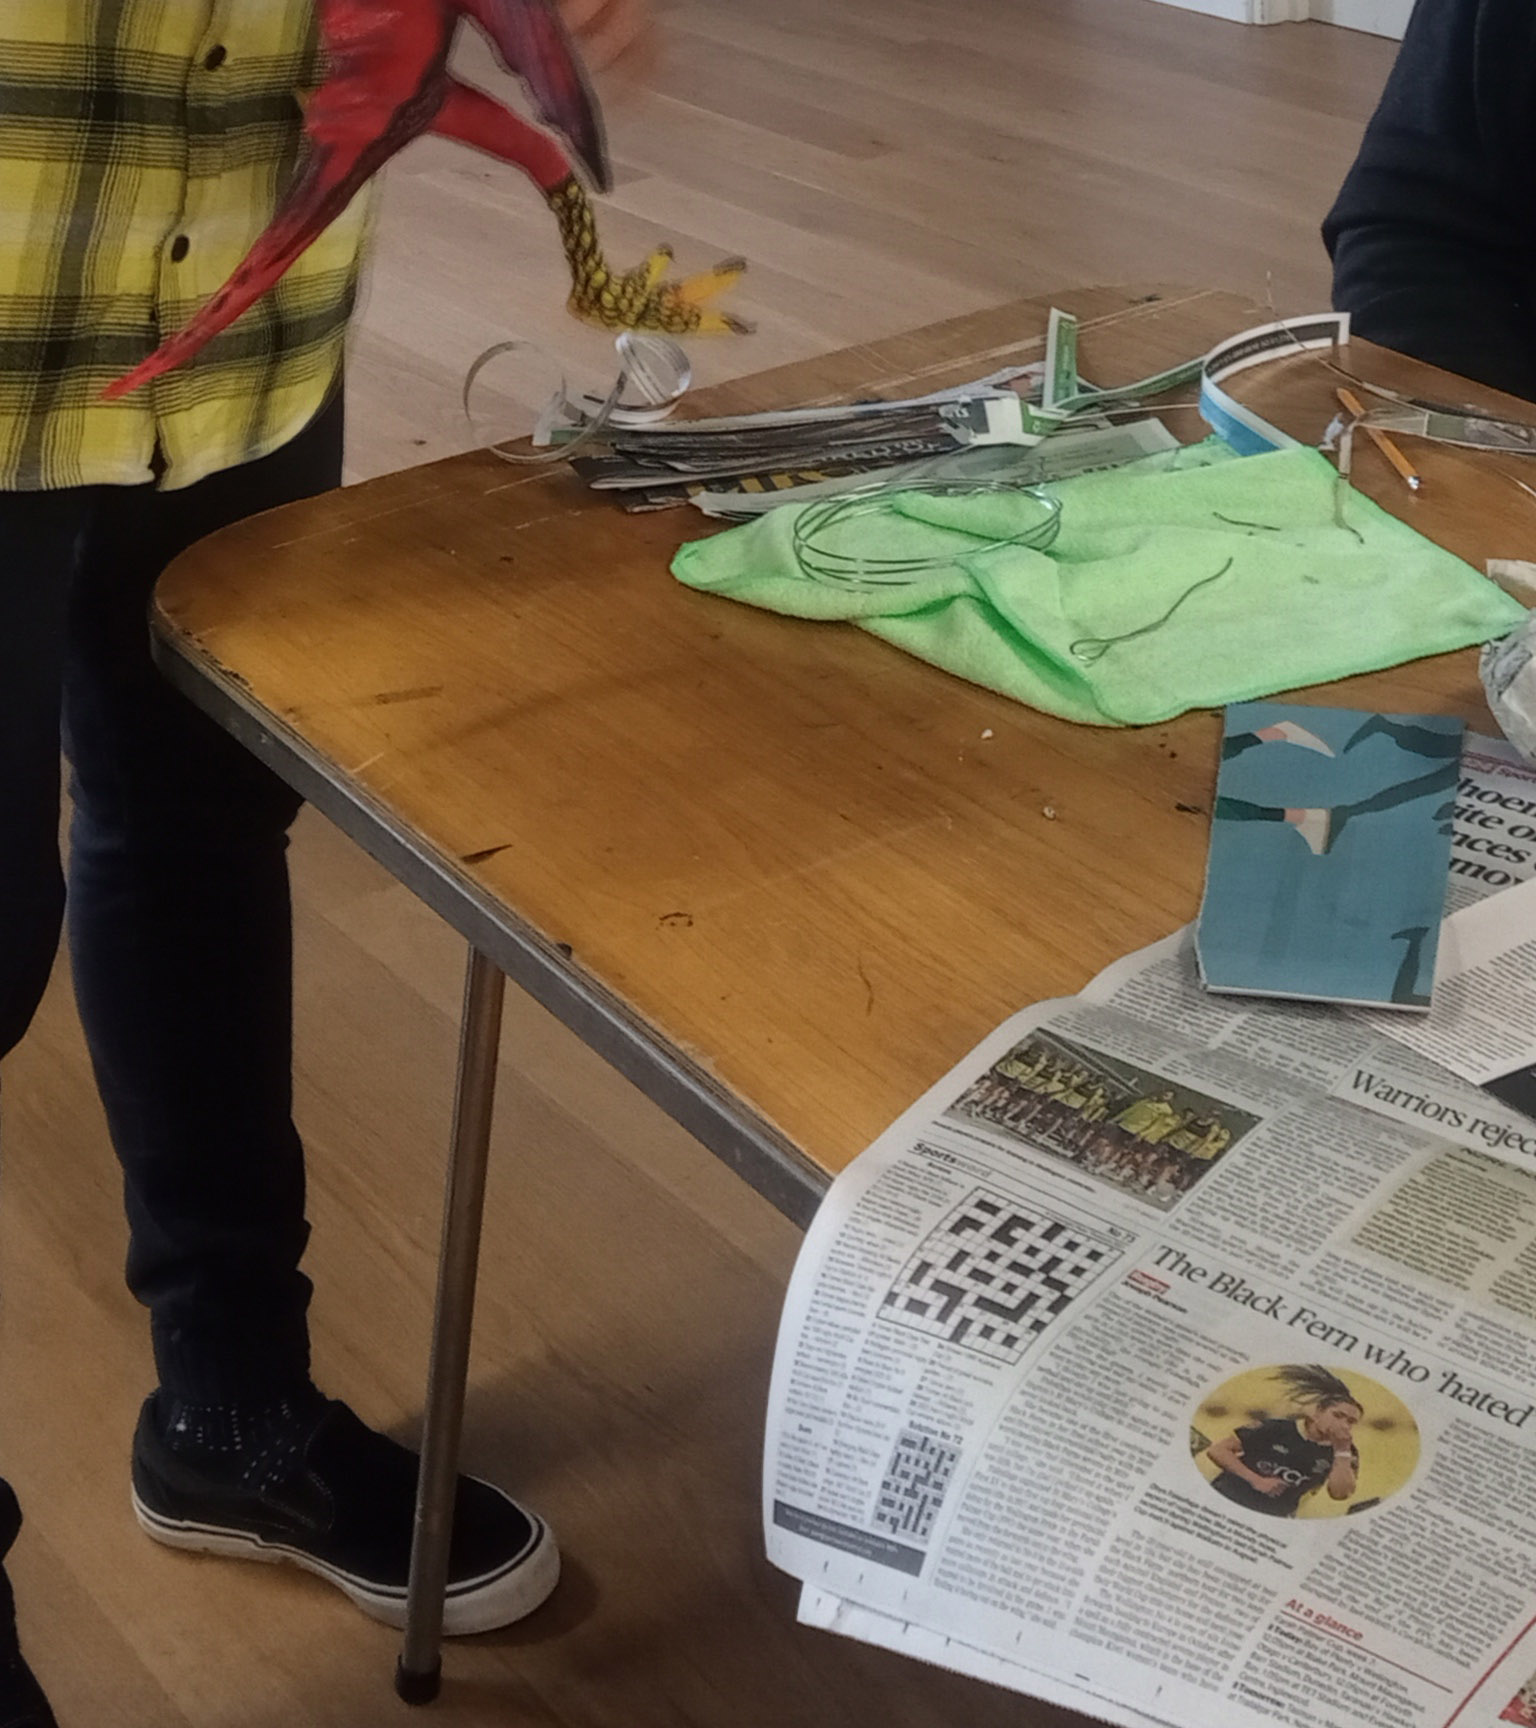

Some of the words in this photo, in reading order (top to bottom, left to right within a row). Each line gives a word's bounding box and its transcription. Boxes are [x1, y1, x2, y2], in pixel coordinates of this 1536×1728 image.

[1452, 831, 1533, 865] nces
[1351, 1069, 1467, 1129] Warriors
[1153, 1243, 1209, 1284] The
[1207, 1270, 1289, 1322] Black
[1287, 1306, 1360, 1353] Fern
[1363, 1342, 1431, 1384] who
[1285, 1598, 1304, 1615] At
[1313, 1611, 1365, 1643] glance
